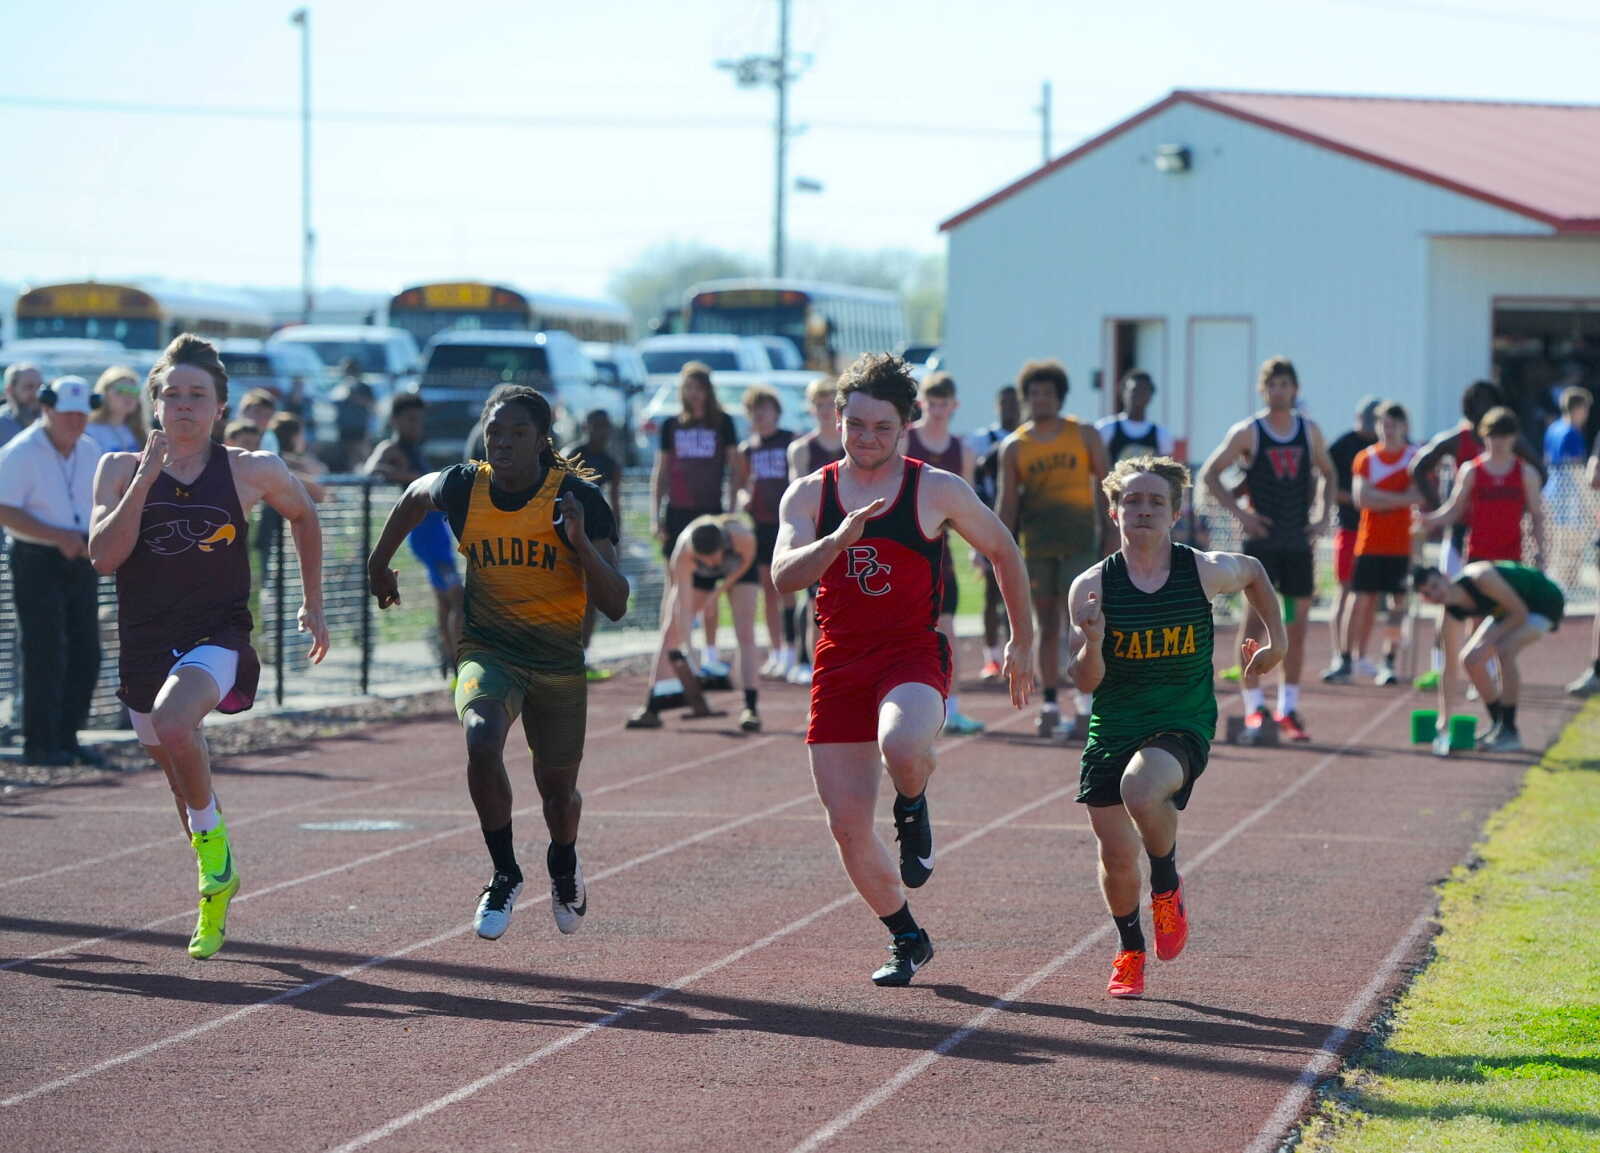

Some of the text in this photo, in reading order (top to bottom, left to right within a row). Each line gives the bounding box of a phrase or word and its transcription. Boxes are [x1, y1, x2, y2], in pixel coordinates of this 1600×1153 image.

[466, 537, 558, 571] MALDEN
[846, 546, 891, 596] BC
[1112, 624, 1196, 659] ZALMA
